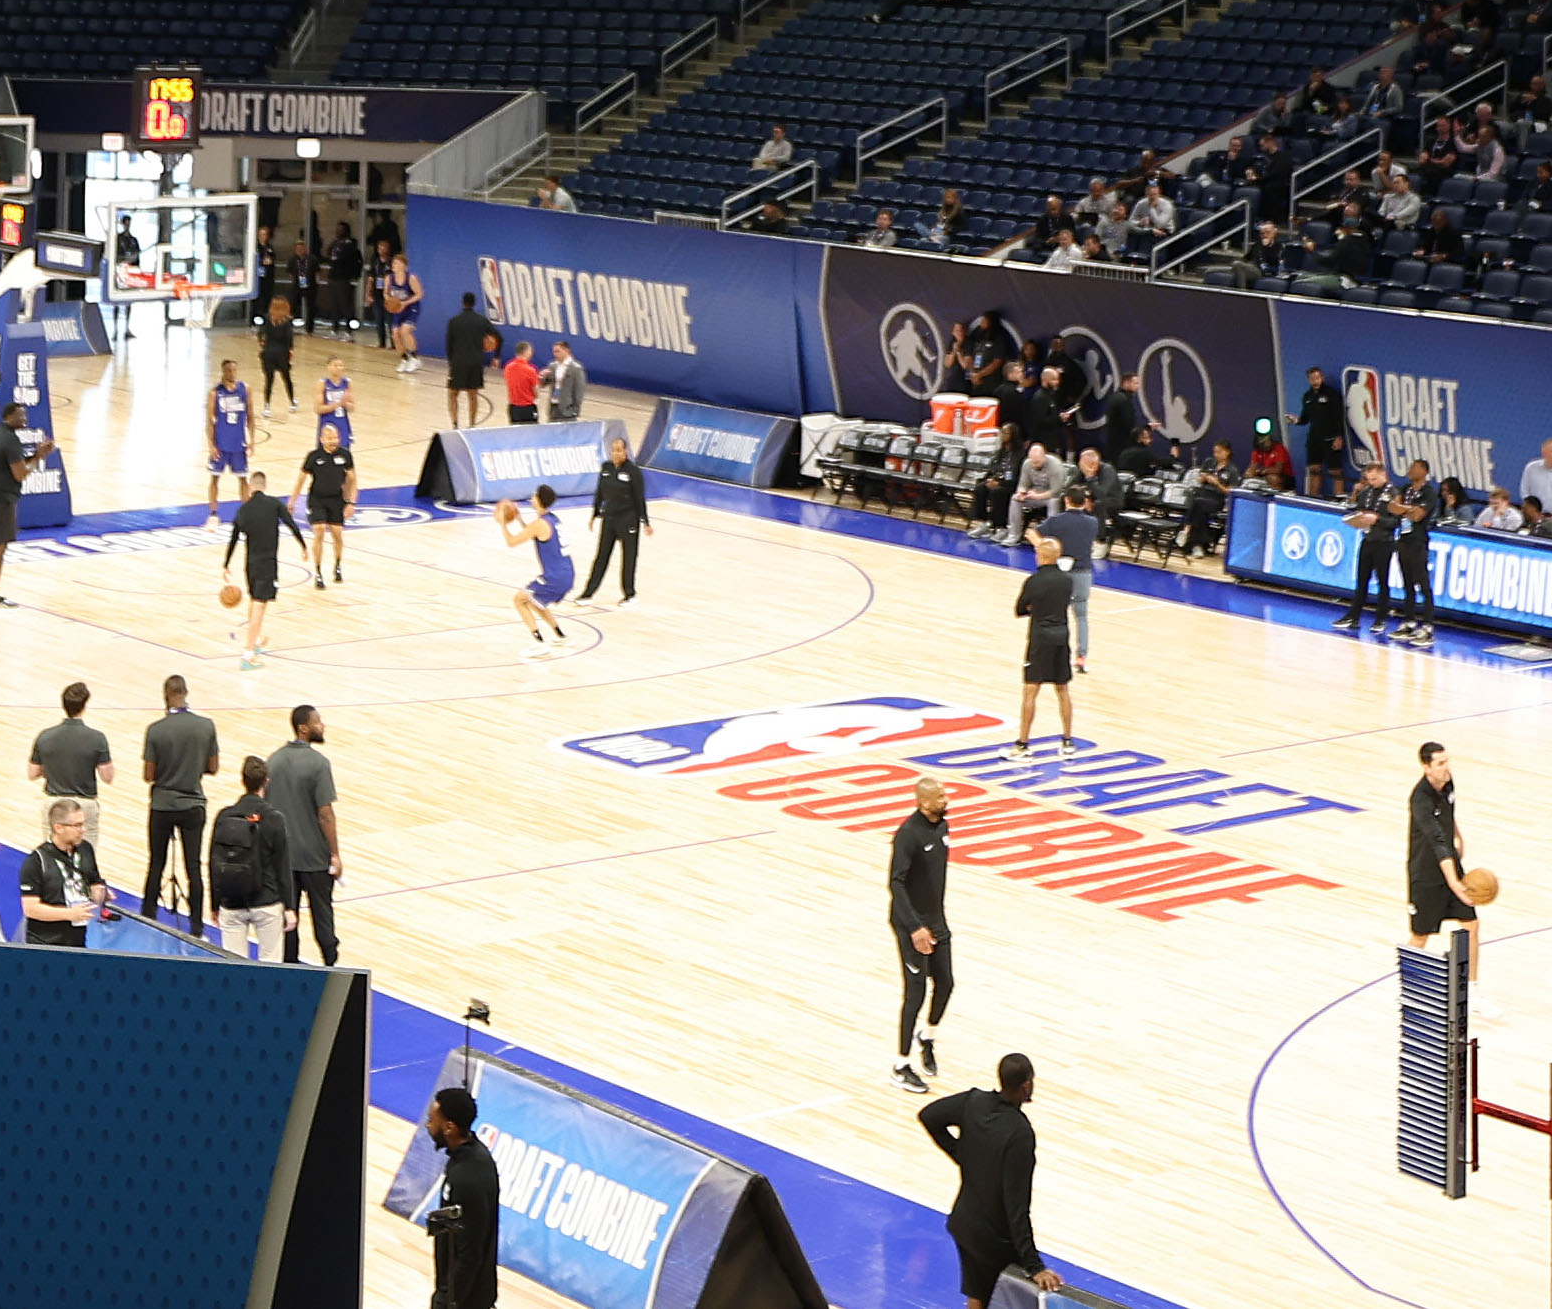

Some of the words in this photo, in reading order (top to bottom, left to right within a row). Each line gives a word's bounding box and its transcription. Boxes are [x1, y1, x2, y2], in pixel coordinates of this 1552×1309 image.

[200, 91, 266, 133] DRAFT
[267, 93, 367, 136] COMBINE
[499, 259, 579, 336] DRAFT
[577, 272, 697, 355] COMBINE
[1385, 374, 1460, 433] DRAFT
[494, 449, 540, 481] DRAFT
[678, 425, 712, 454] DRAFT
[705, 430, 761, 464] COMBINE
[905, 734, 1370, 836] DRAFT
[545, 1162, 670, 1270] COMBINE
